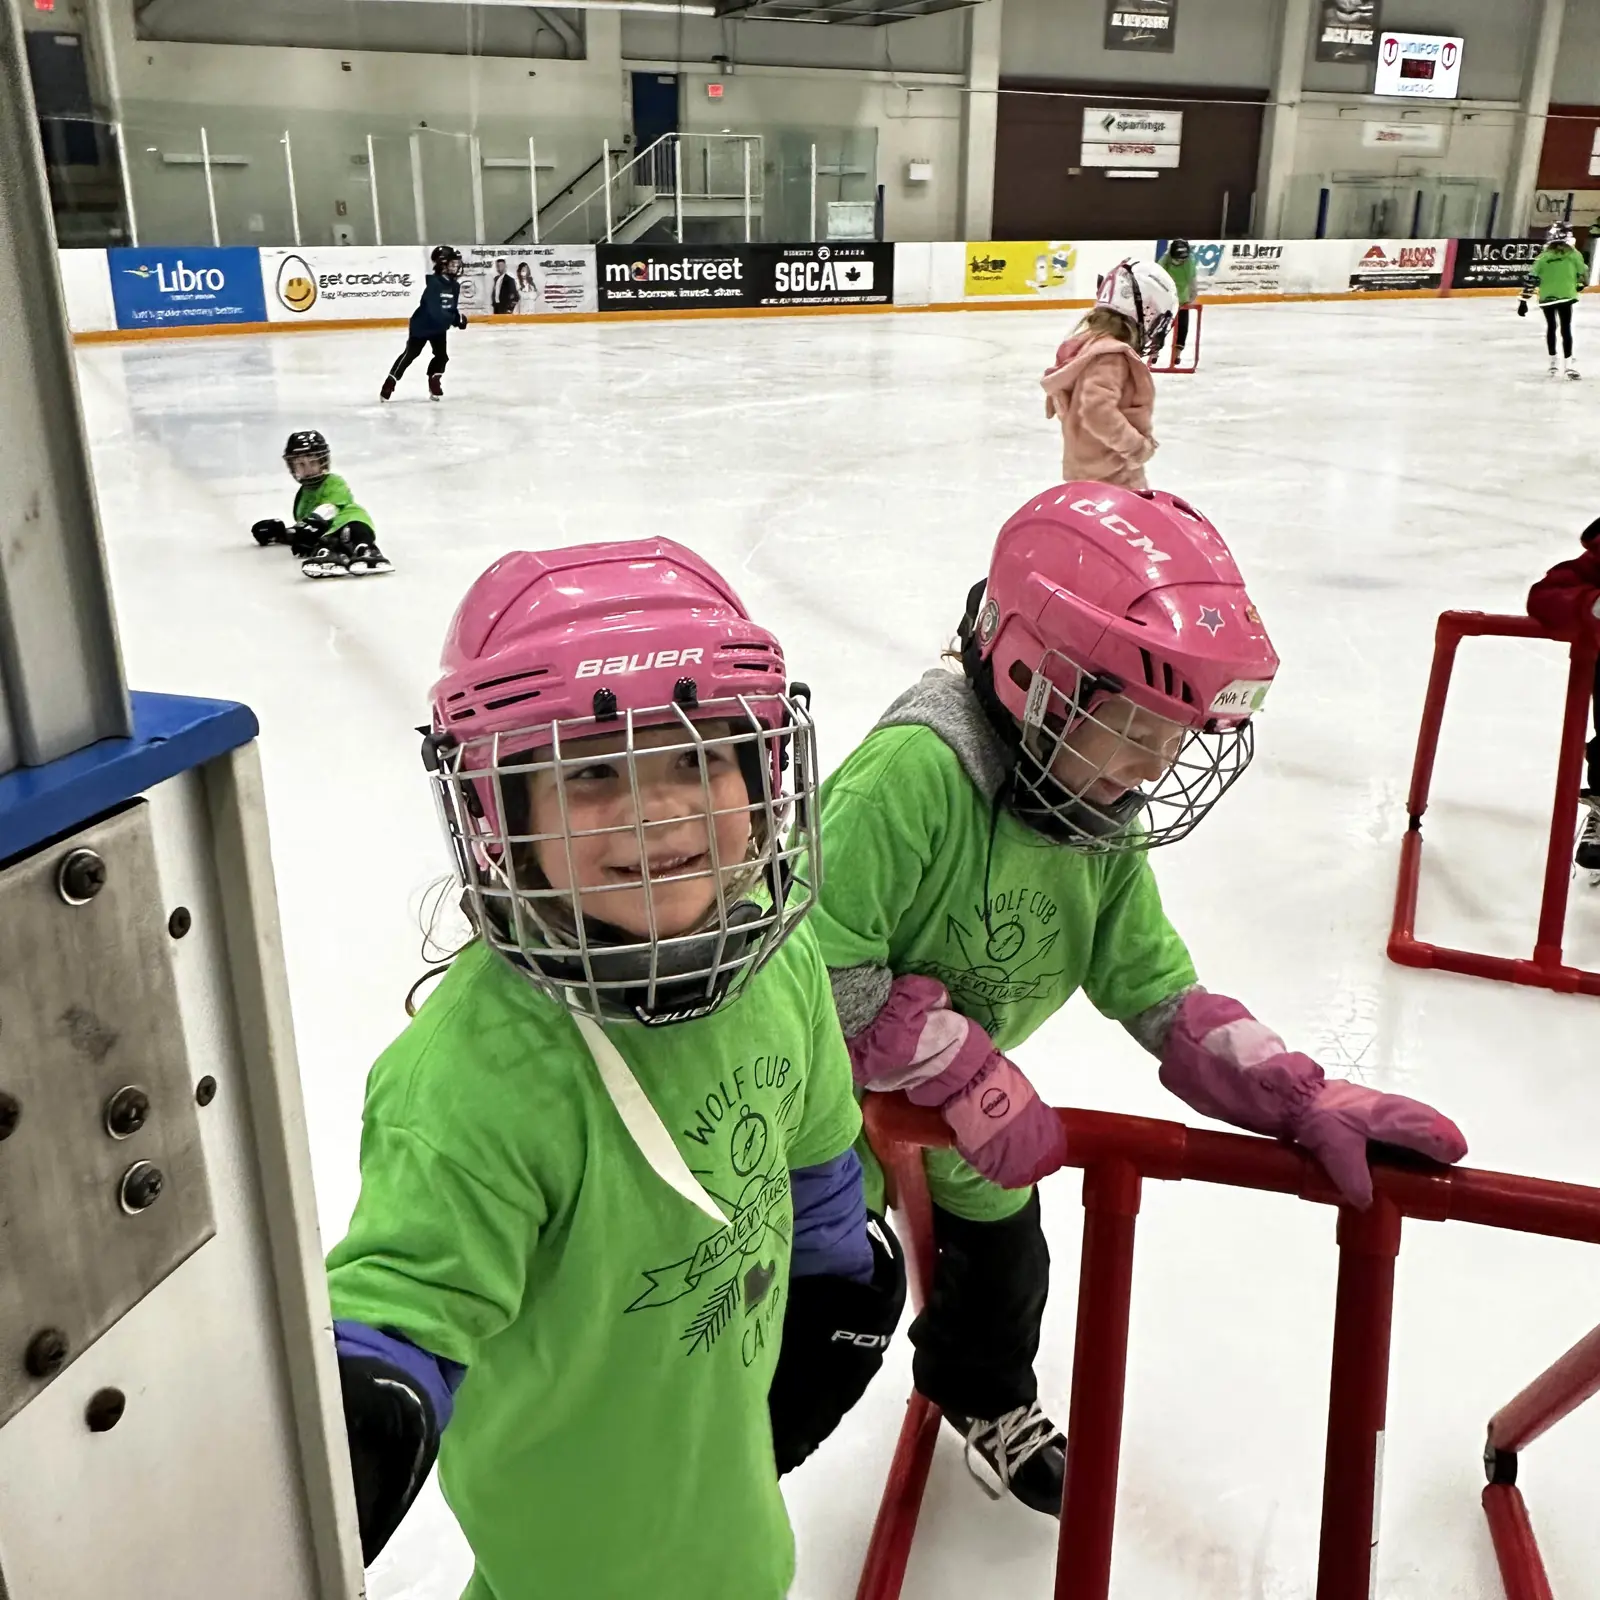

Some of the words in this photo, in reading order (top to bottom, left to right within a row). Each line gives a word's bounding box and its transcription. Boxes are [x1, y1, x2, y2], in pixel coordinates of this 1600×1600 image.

[157, 260, 225, 292] Libro
[319, 273, 344, 288] get
[605, 258, 743, 281] mainstreet
[775, 261, 836, 292] SGCA
[1069, 498, 1172, 578] CCM
[1214, 691, 1237, 706] AVA
[974, 888, 1028, 922] WOLF
[1029, 891, 1057, 925] CUB
[684, 1066, 744, 1145] WOLF
[754, 1056, 791, 1089] CUB
[699, 1172, 789, 1268] ADVENTURE
